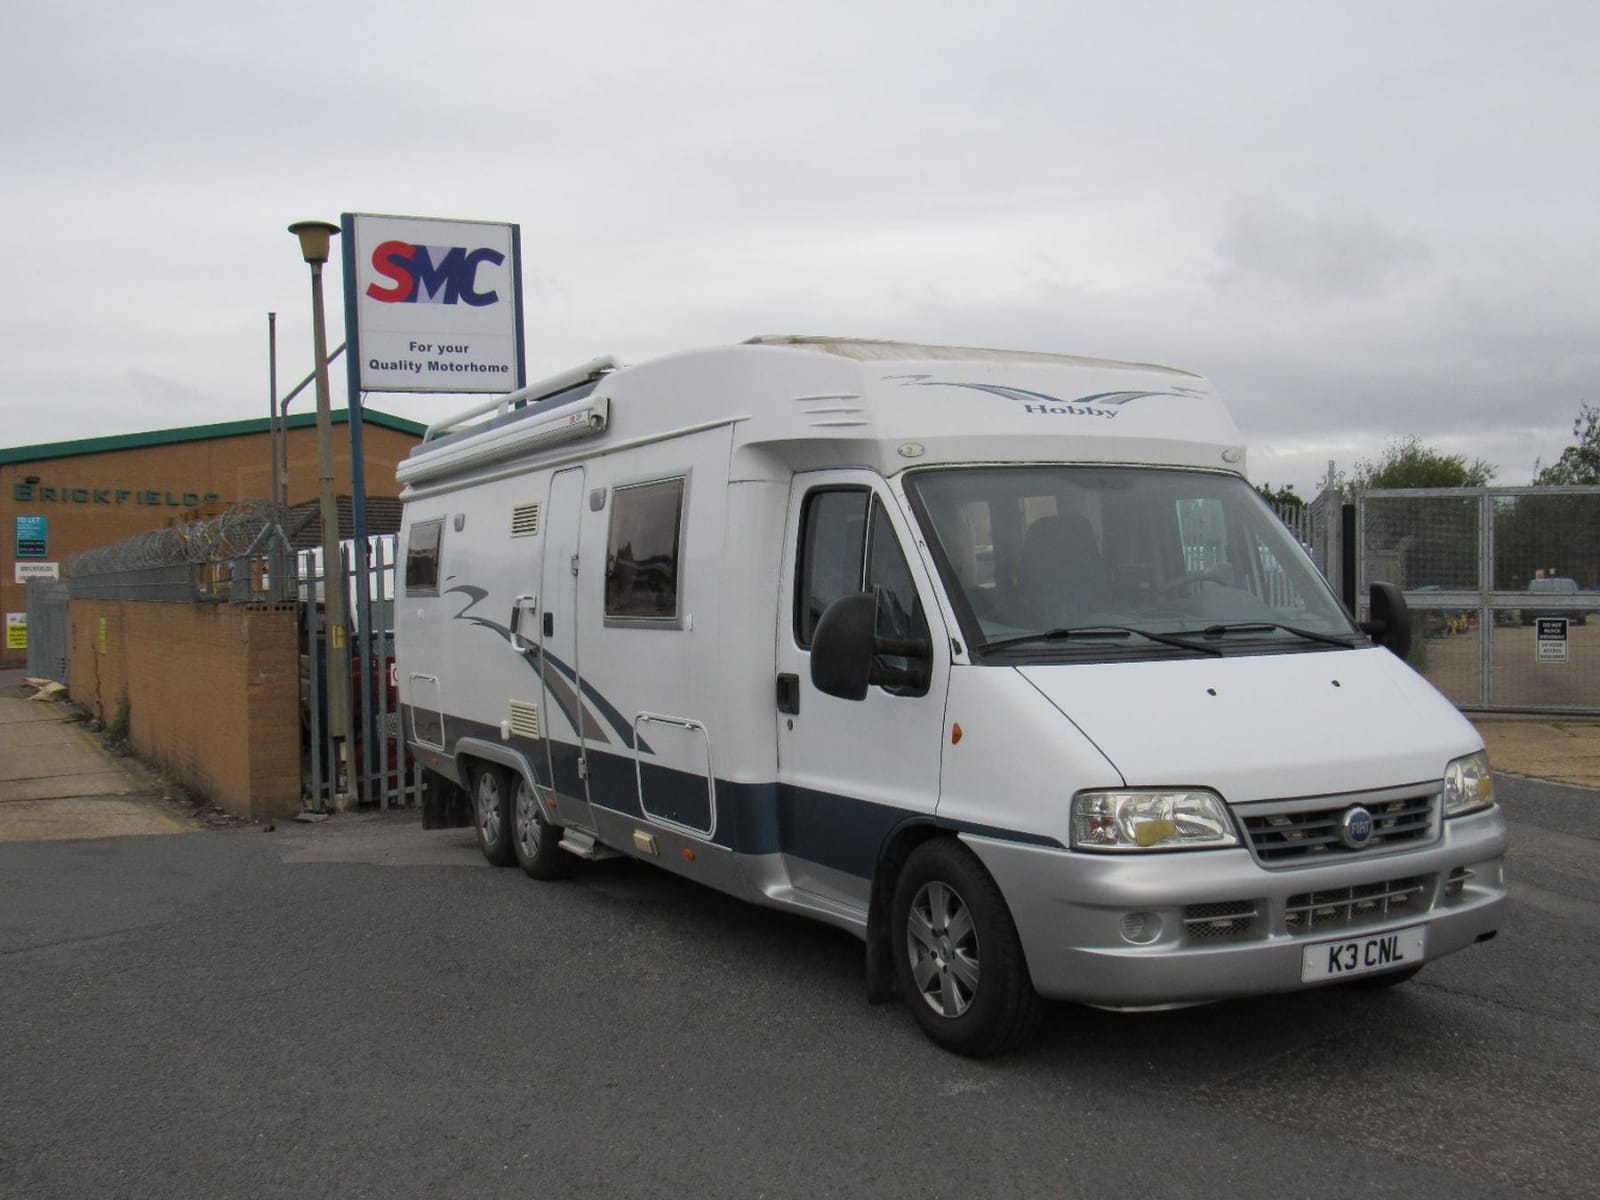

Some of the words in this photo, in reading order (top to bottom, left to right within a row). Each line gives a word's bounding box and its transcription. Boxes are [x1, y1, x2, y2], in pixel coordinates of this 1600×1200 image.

[366, 240, 506, 307] SMC
[409, 341, 433, 352] For
[438, 345, 469, 355] your
[369, 359, 422, 373] Quality
[428, 361, 509, 373] Motorhome
[1024, 404, 1118, 419] Hobby
[1351, 820, 1369, 834] FIAT
[1328, 943, 1358, 973] K3
[1364, 936, 1403, 967] CNL
